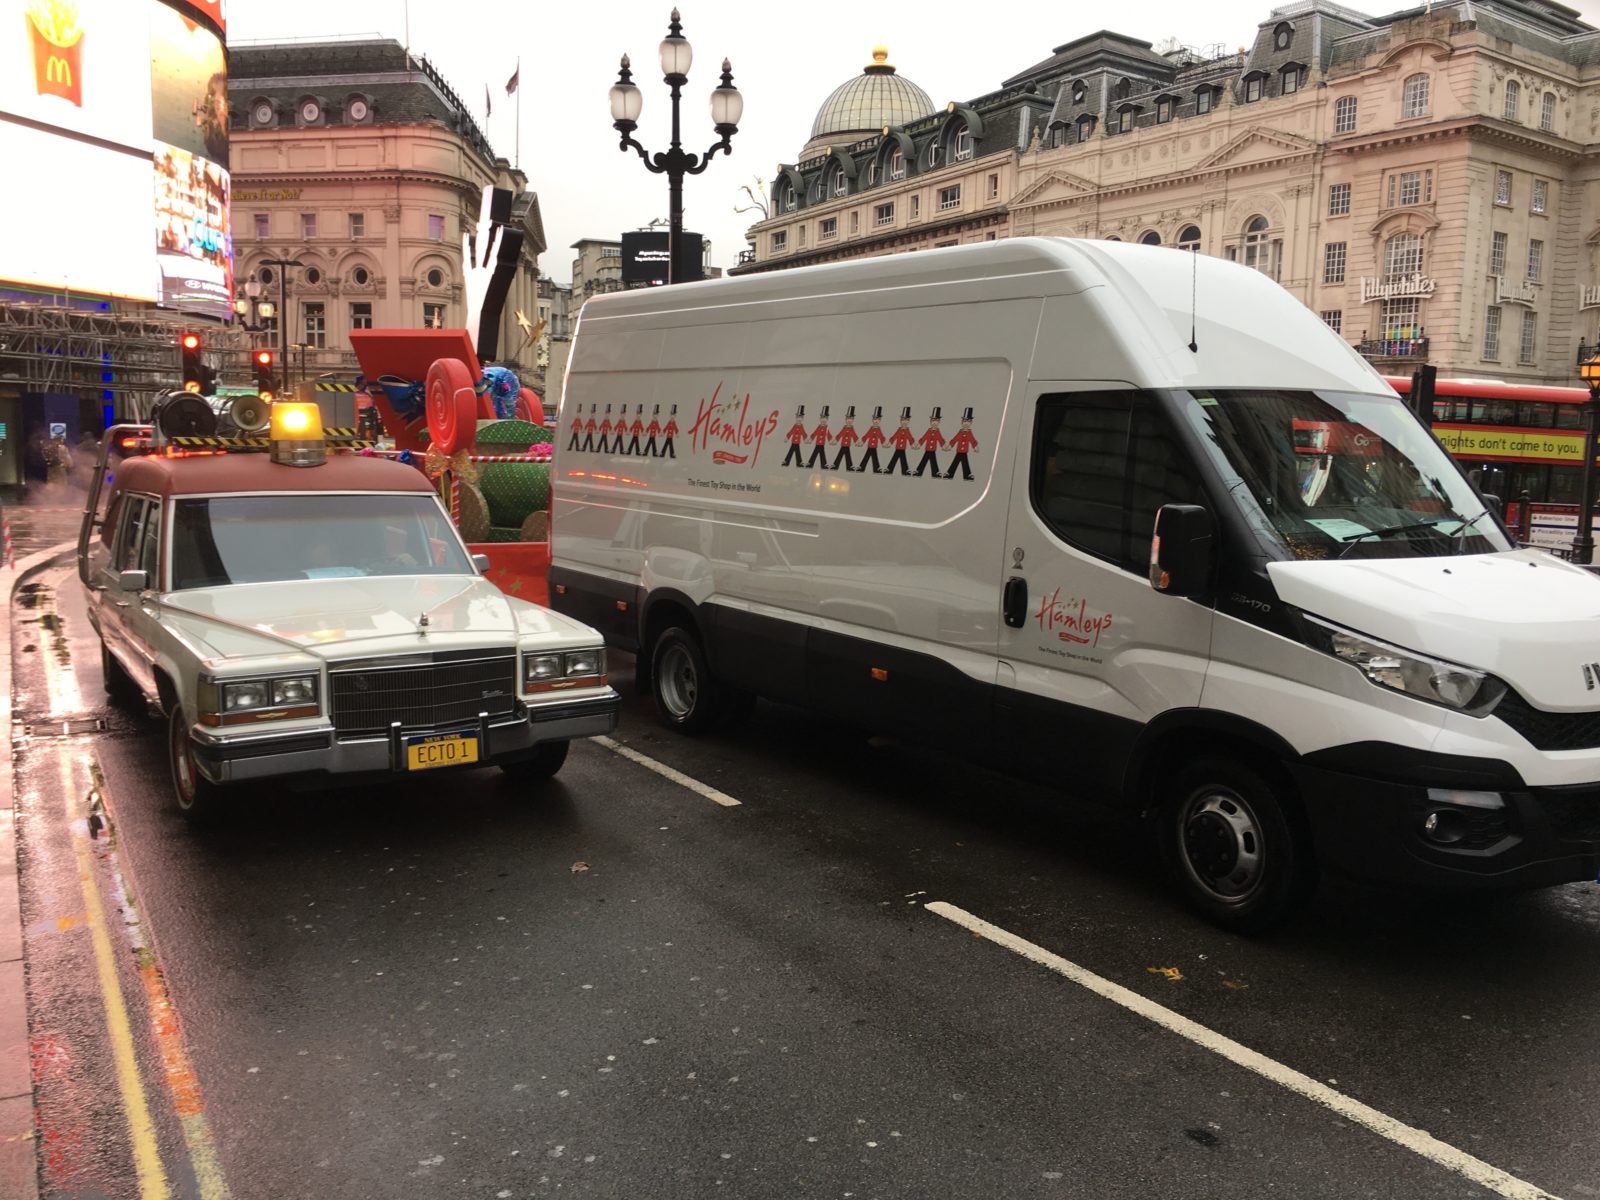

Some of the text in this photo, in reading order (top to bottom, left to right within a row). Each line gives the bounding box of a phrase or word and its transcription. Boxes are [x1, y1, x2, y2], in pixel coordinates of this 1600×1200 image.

[1360, 273, 1437, 304] Lillywhites
[688, 380, 779, 469] Hamleys
[1440, 435, 1580, 455] nights don't come to you.
[720, 481, 731, 490] Shop
[1035, 586, 1112, 648] Hamleys
[418, 741, 469, 763] ECTO 1
